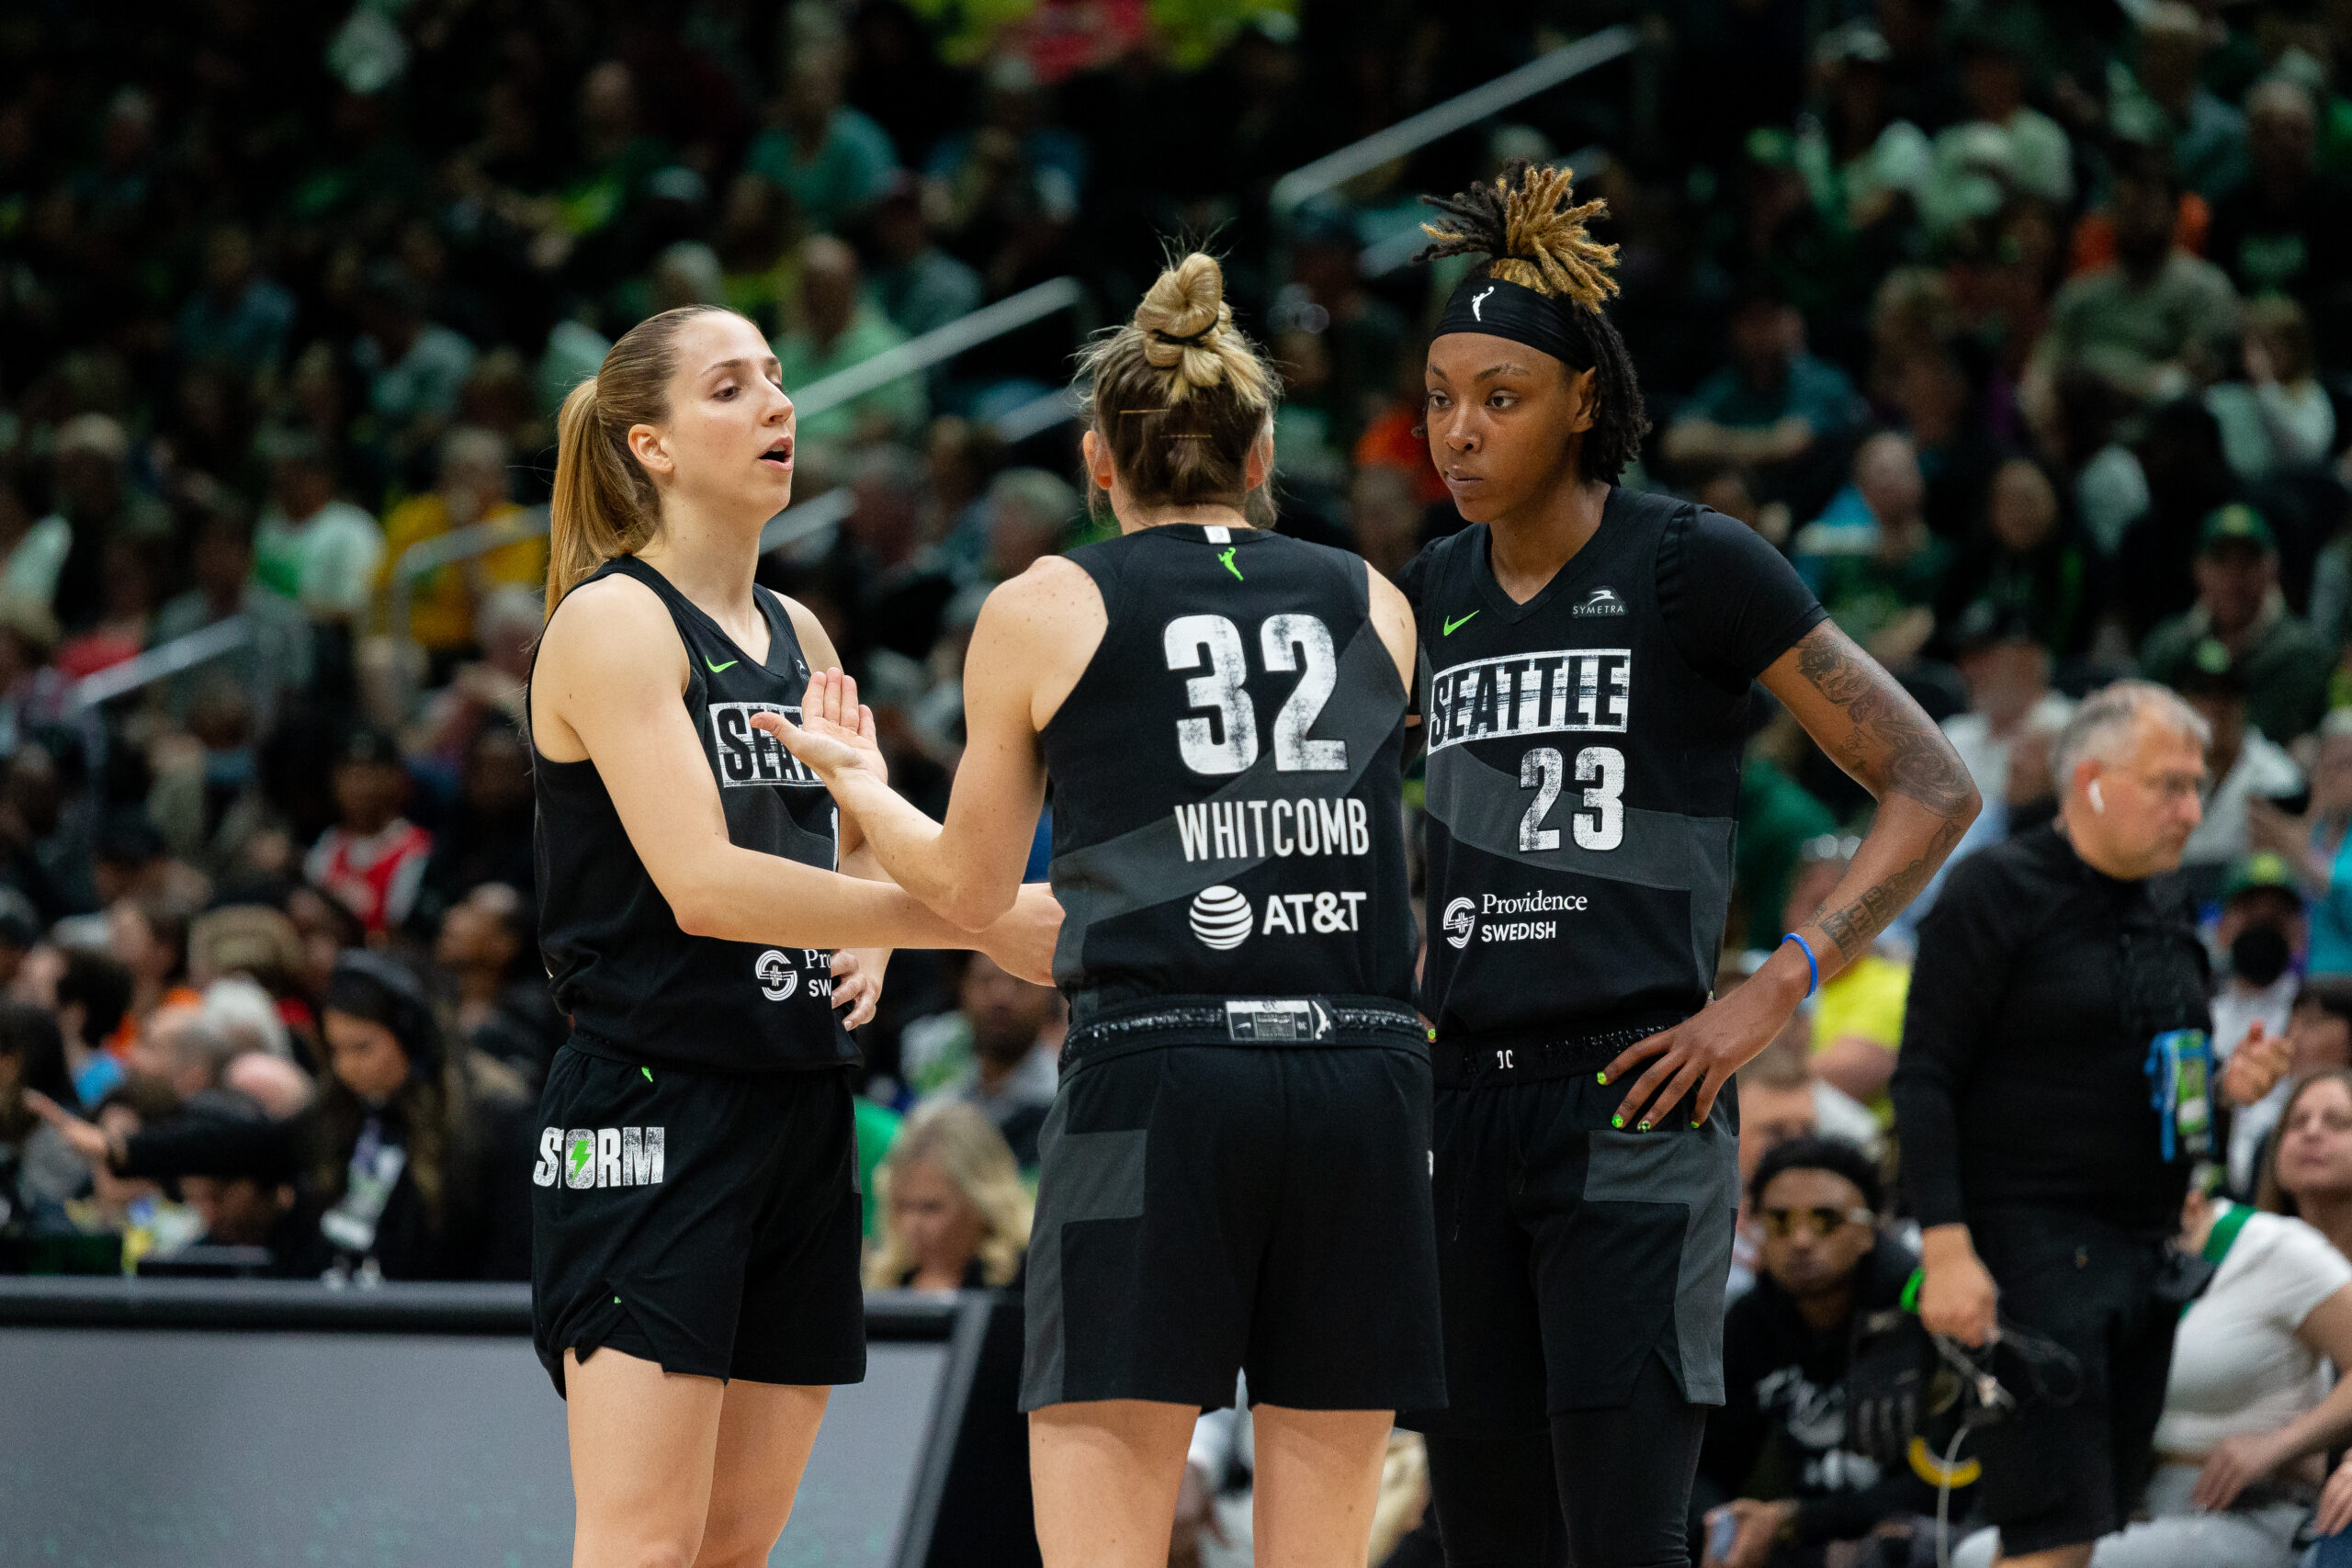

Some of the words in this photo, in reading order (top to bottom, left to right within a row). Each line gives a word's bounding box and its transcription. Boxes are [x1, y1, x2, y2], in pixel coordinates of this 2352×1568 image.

[1572, 604, 1624, 615] SYMETRA
[1163, 613, 1350, 775] 32
[1430, 655, 1625, 748] SEATTLE
[716, 707, 816, 782] SEAT
[1174, 797, 1370, 863] WHITCOMB
[1519, 747, 1626, 852] 23
[1261, 891, 1368, 936] AT&T
[1481, 889, 1589, 915] Providence
[1481, 920, 1556, 943] SWEDISH
[532, 1126, 665, 1190] SORM
